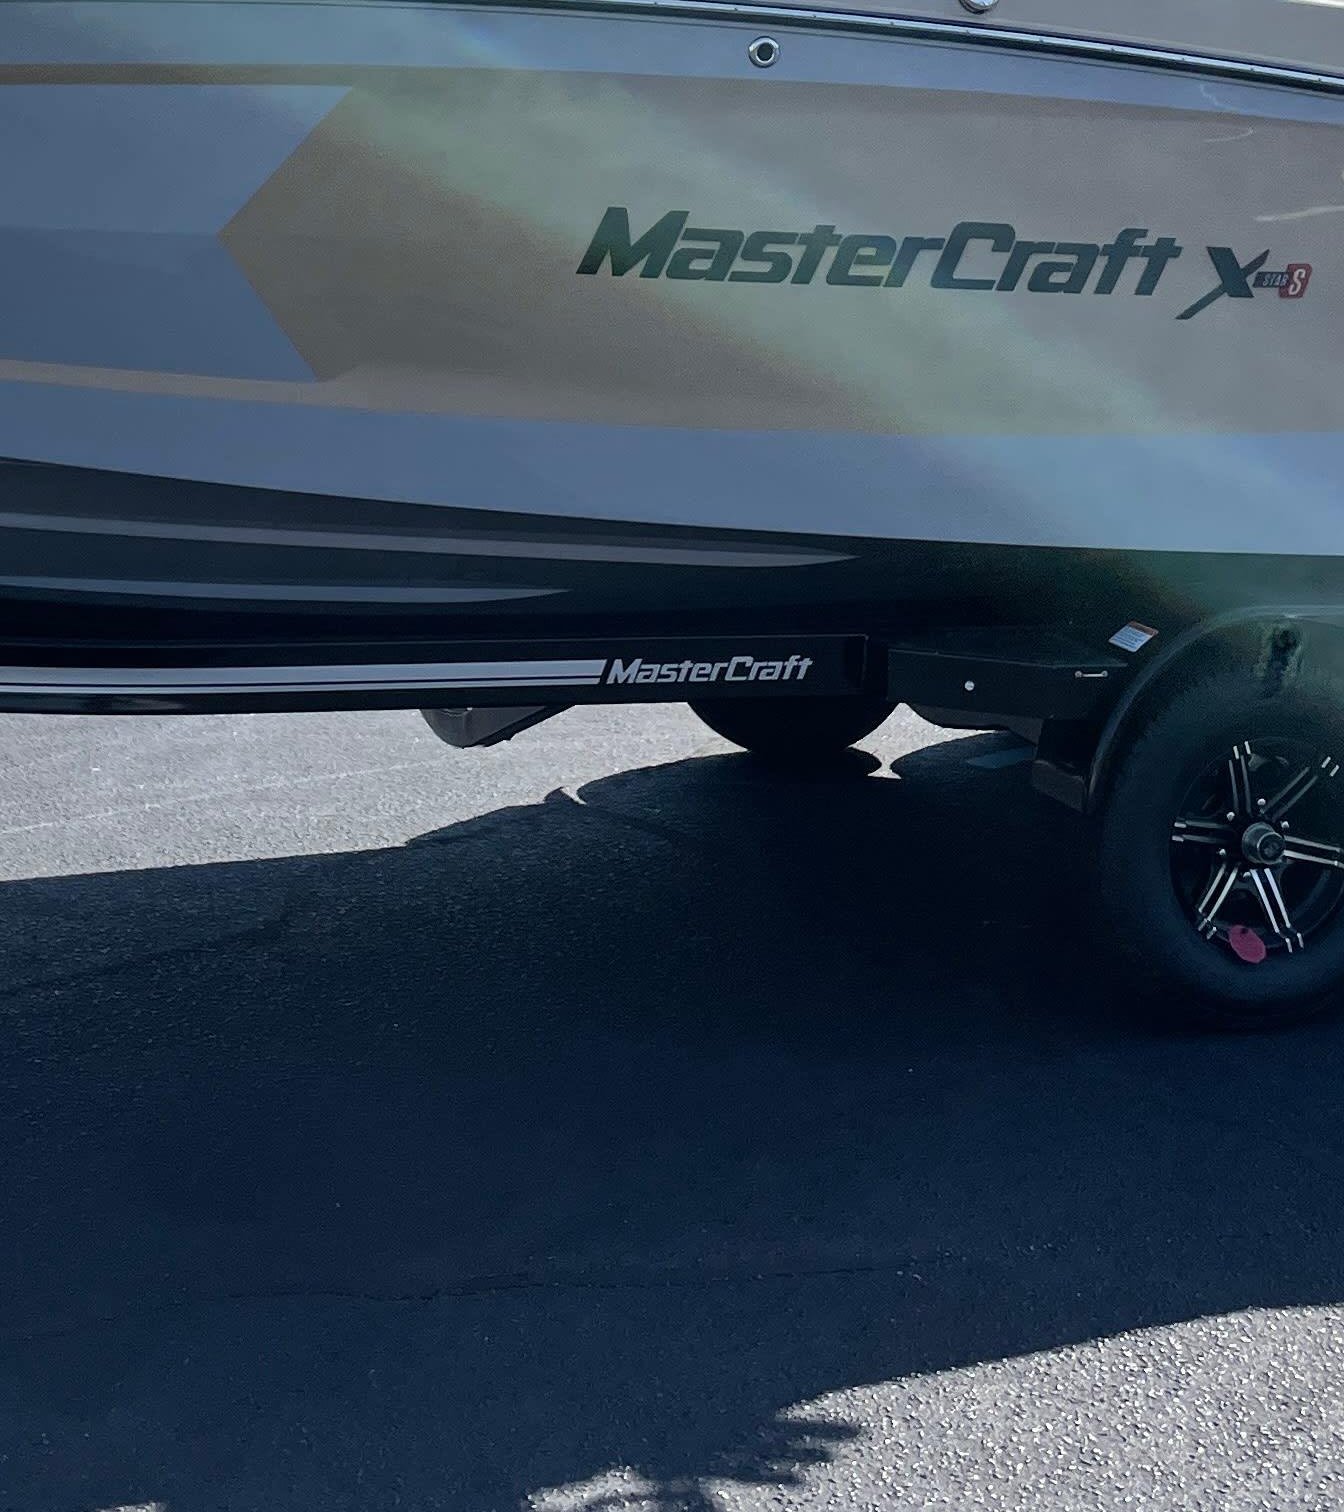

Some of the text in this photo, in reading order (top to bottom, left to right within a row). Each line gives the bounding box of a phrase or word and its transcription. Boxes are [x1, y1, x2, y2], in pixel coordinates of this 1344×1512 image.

[576, 207, 1182, 296] MasterCraft
[1262, 273, 1290, 287] STAR
[1288, 268, 1306, 295] S
[606, 654, 813, 685] MasterCraft
